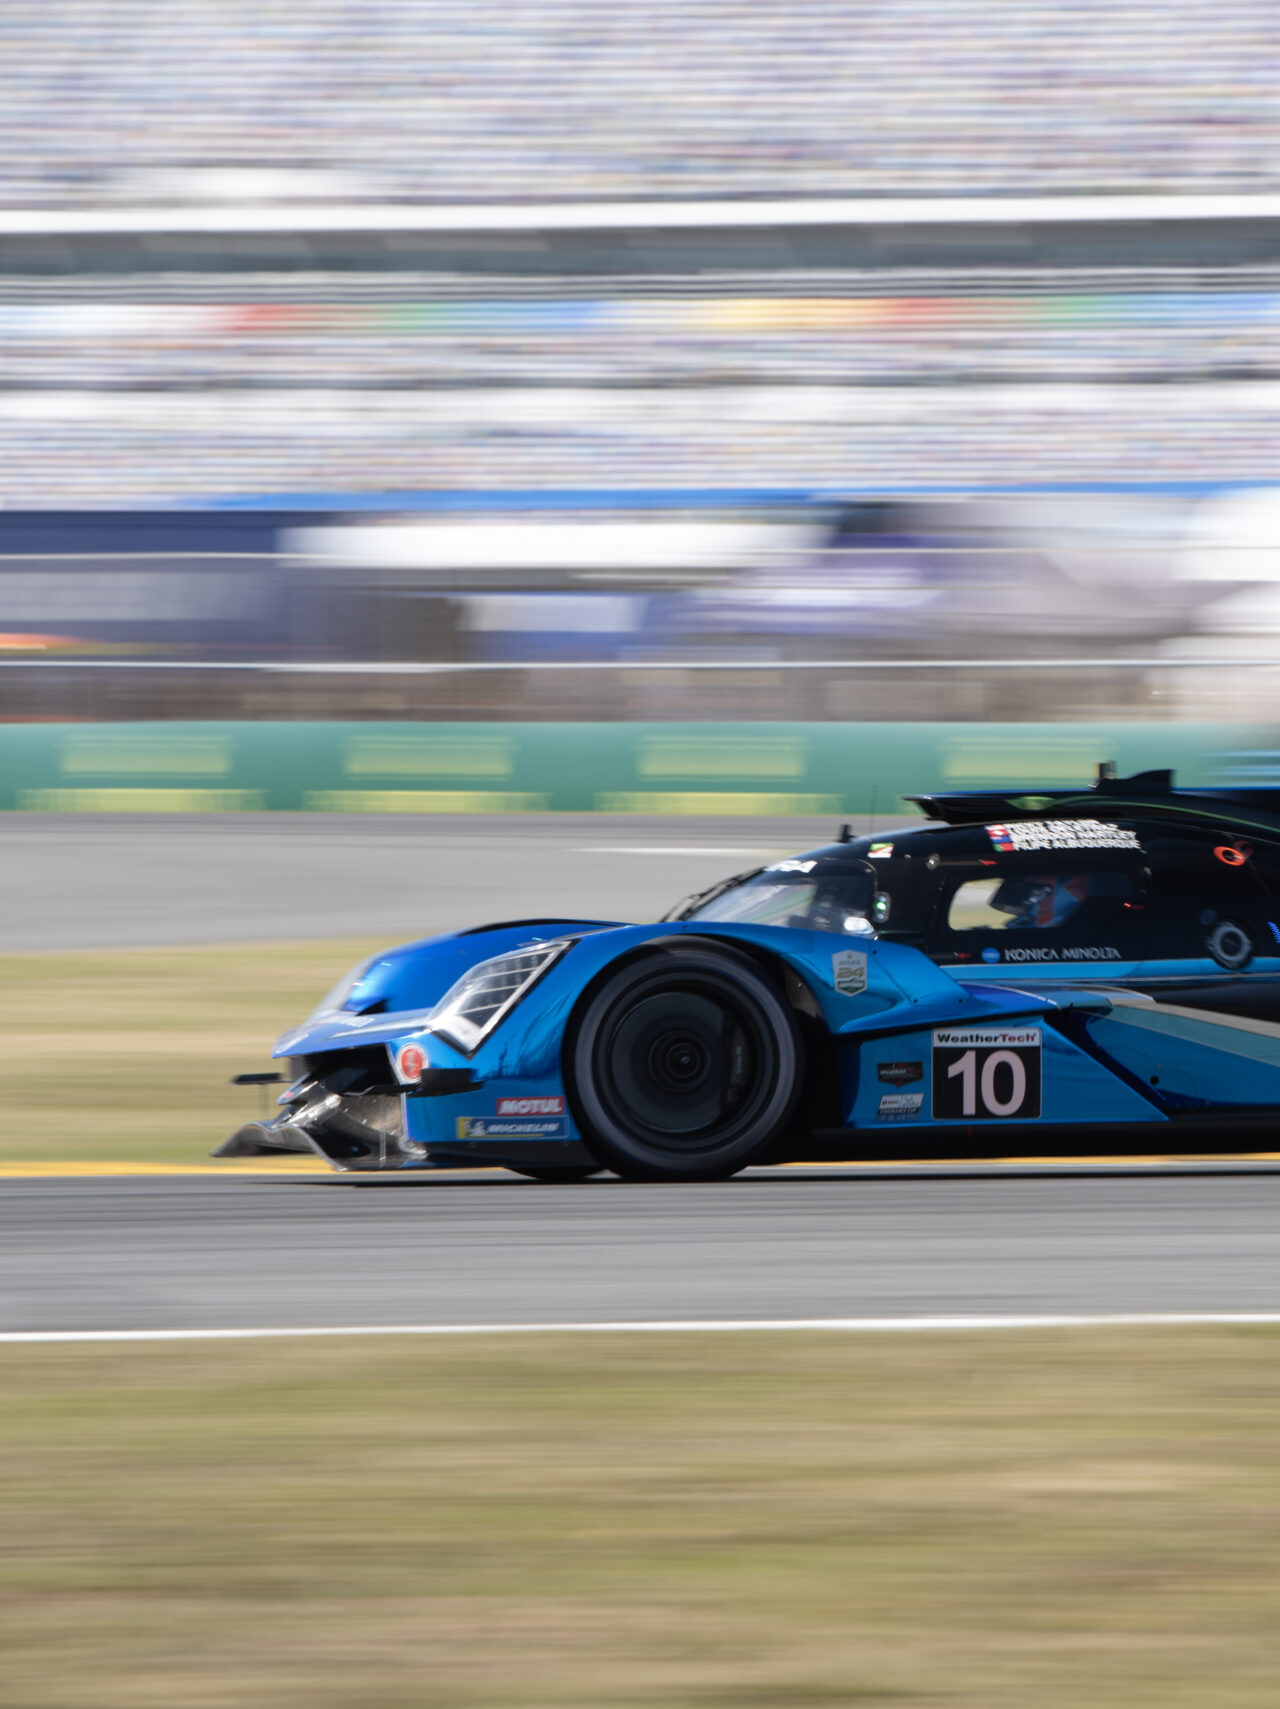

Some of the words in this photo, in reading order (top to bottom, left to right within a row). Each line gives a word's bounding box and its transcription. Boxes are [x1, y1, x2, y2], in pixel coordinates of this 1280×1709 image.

[1004, 948, 1060, 961] KONICA
[1061, 946, 1122, 960] MINOLTA
[937, 1032, 1036, 1044] WeatherTech
[947, 1049, 1027, 1117] 10
[498, 1099, 563, 1114] MOTUL
[487, 1122, 560, 1133] MICHELIN
